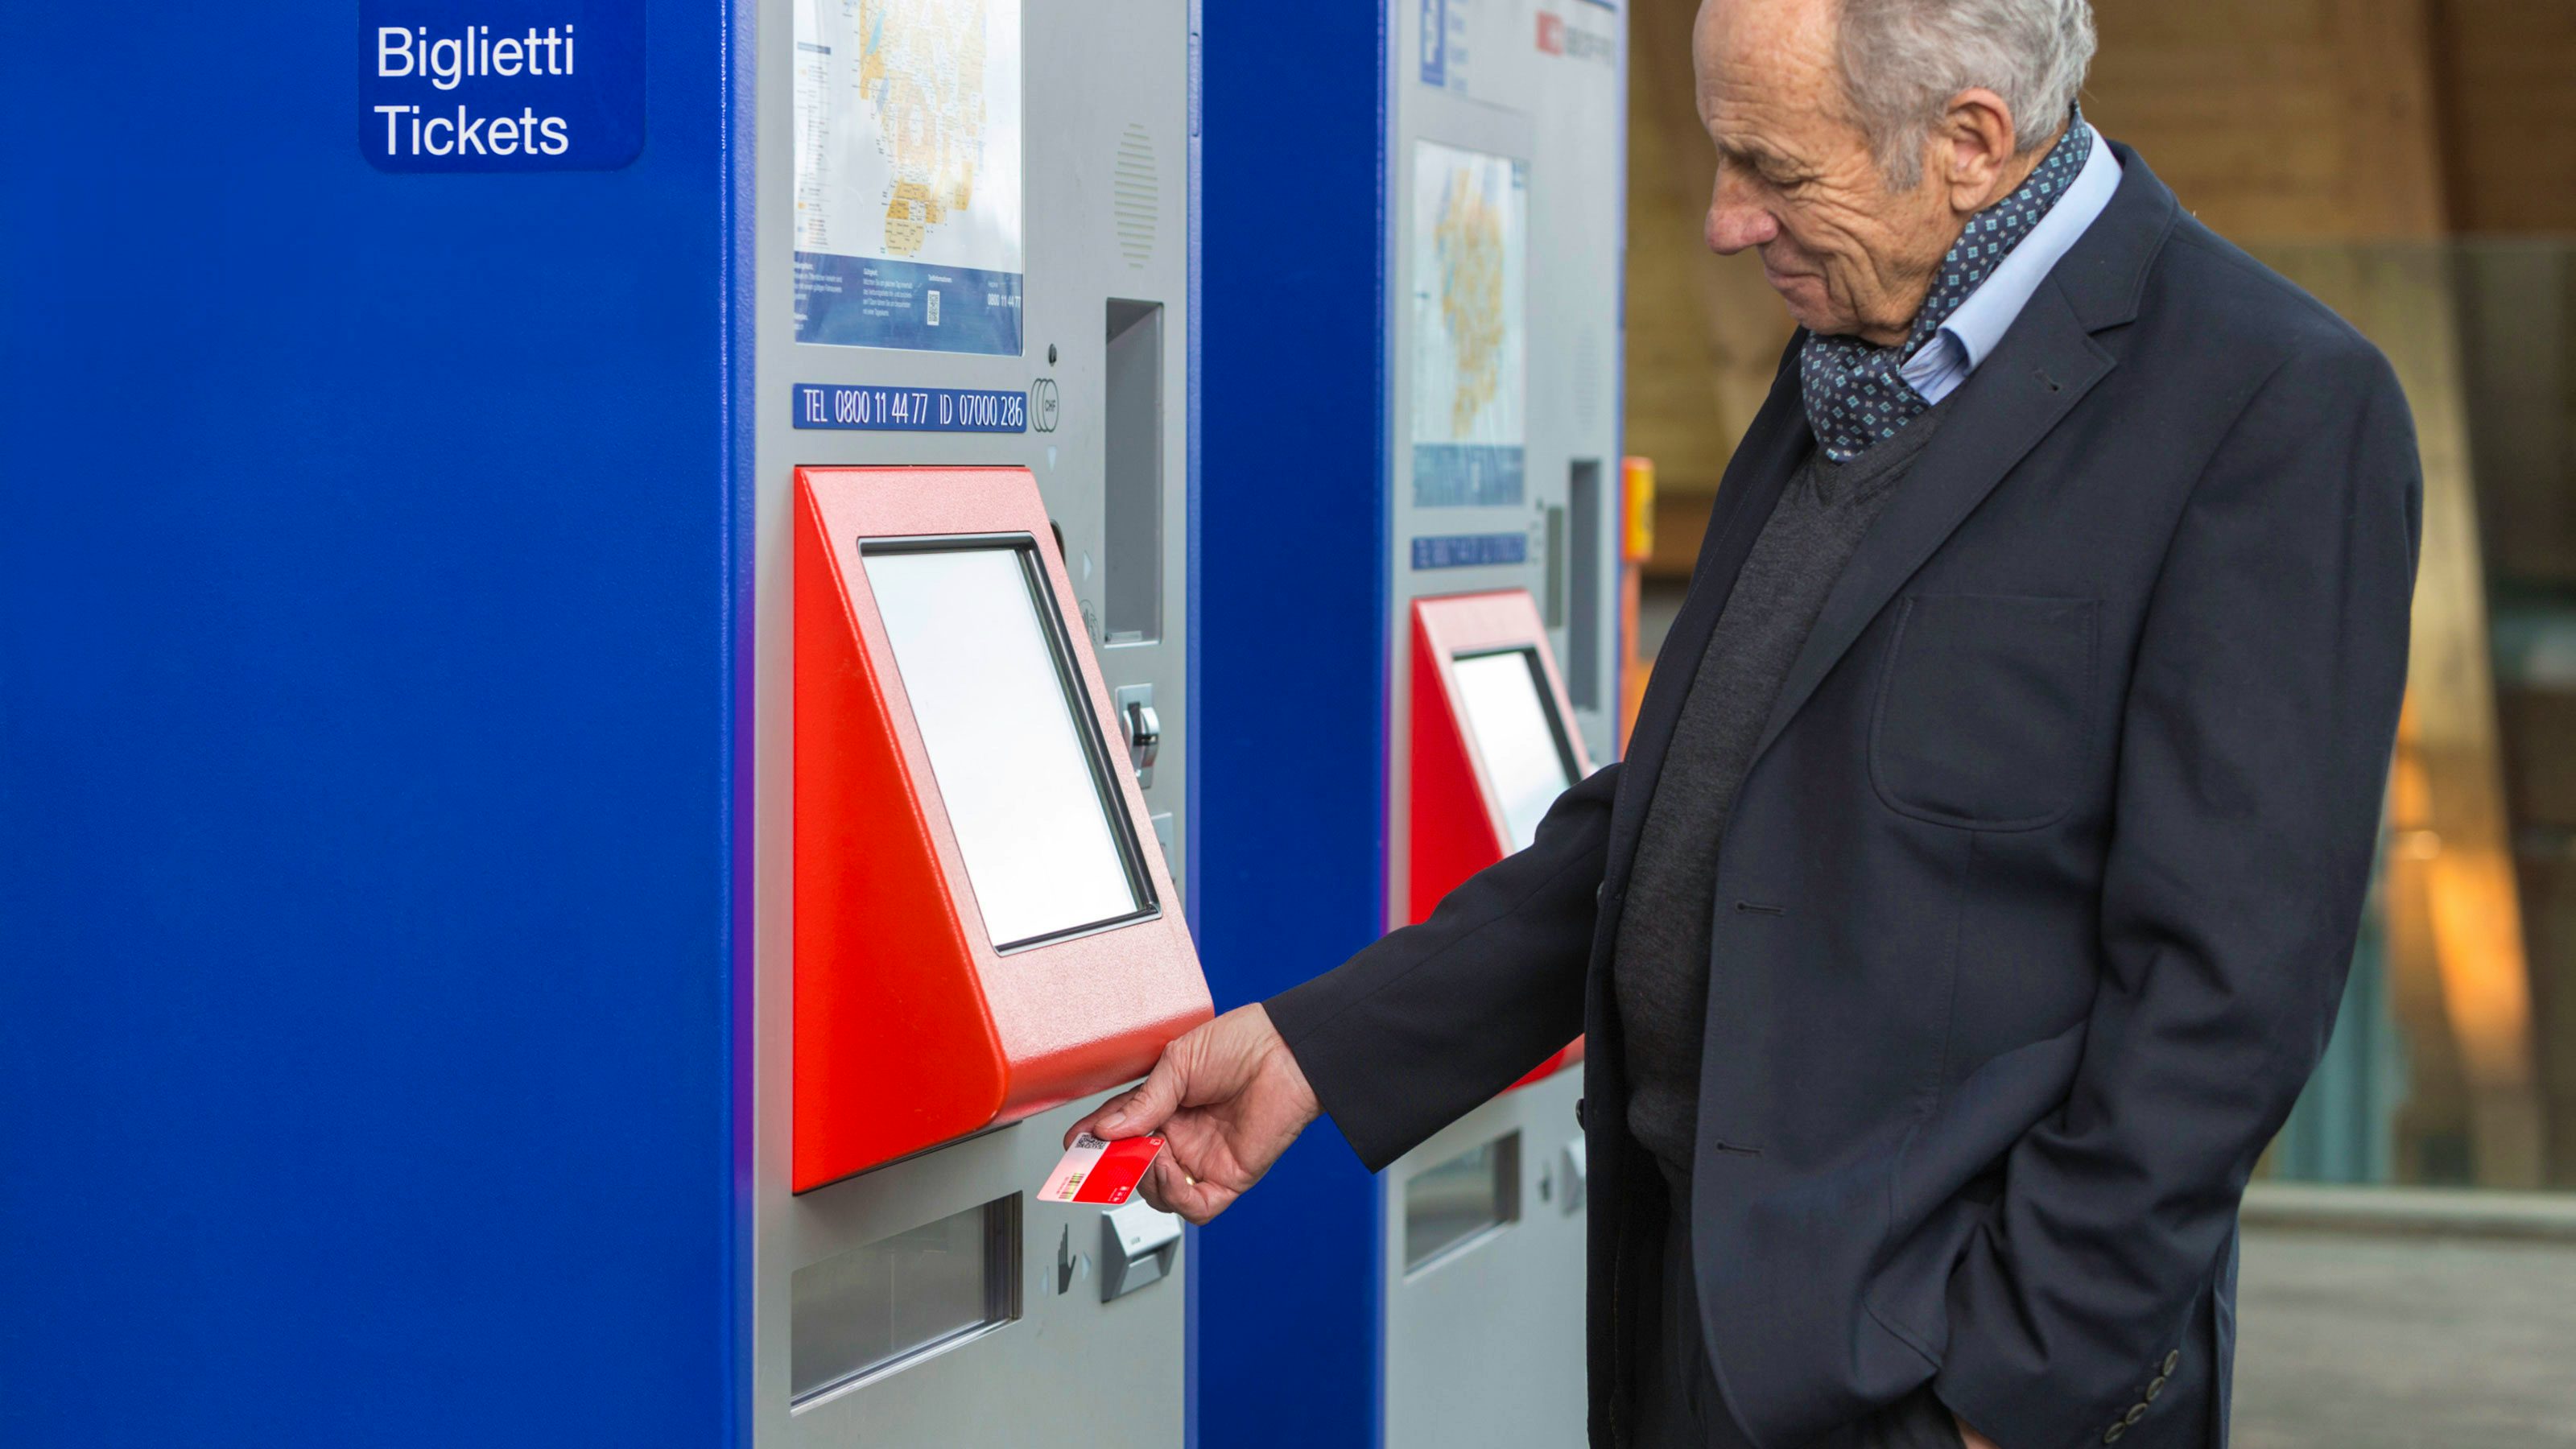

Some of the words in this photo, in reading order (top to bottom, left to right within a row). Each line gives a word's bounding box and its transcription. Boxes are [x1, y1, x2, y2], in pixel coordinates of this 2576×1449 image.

[378, 24, 574, 90] Biglietti
[374, 105, 569, 155] Tickets
[1001, 295, 1007, 307] 11
[803, 389, 828, 423] TEL
[835, 390, 870, 423] 0800
[875, 391, 886, 423] 11
[891, 392, 909, 424] 44
[912, 393, 928, 424] 77
[939, 393, 953, 425] ID
[959, 394, 997, 427] 07000
[1001, 395, 1023, 427] 286
